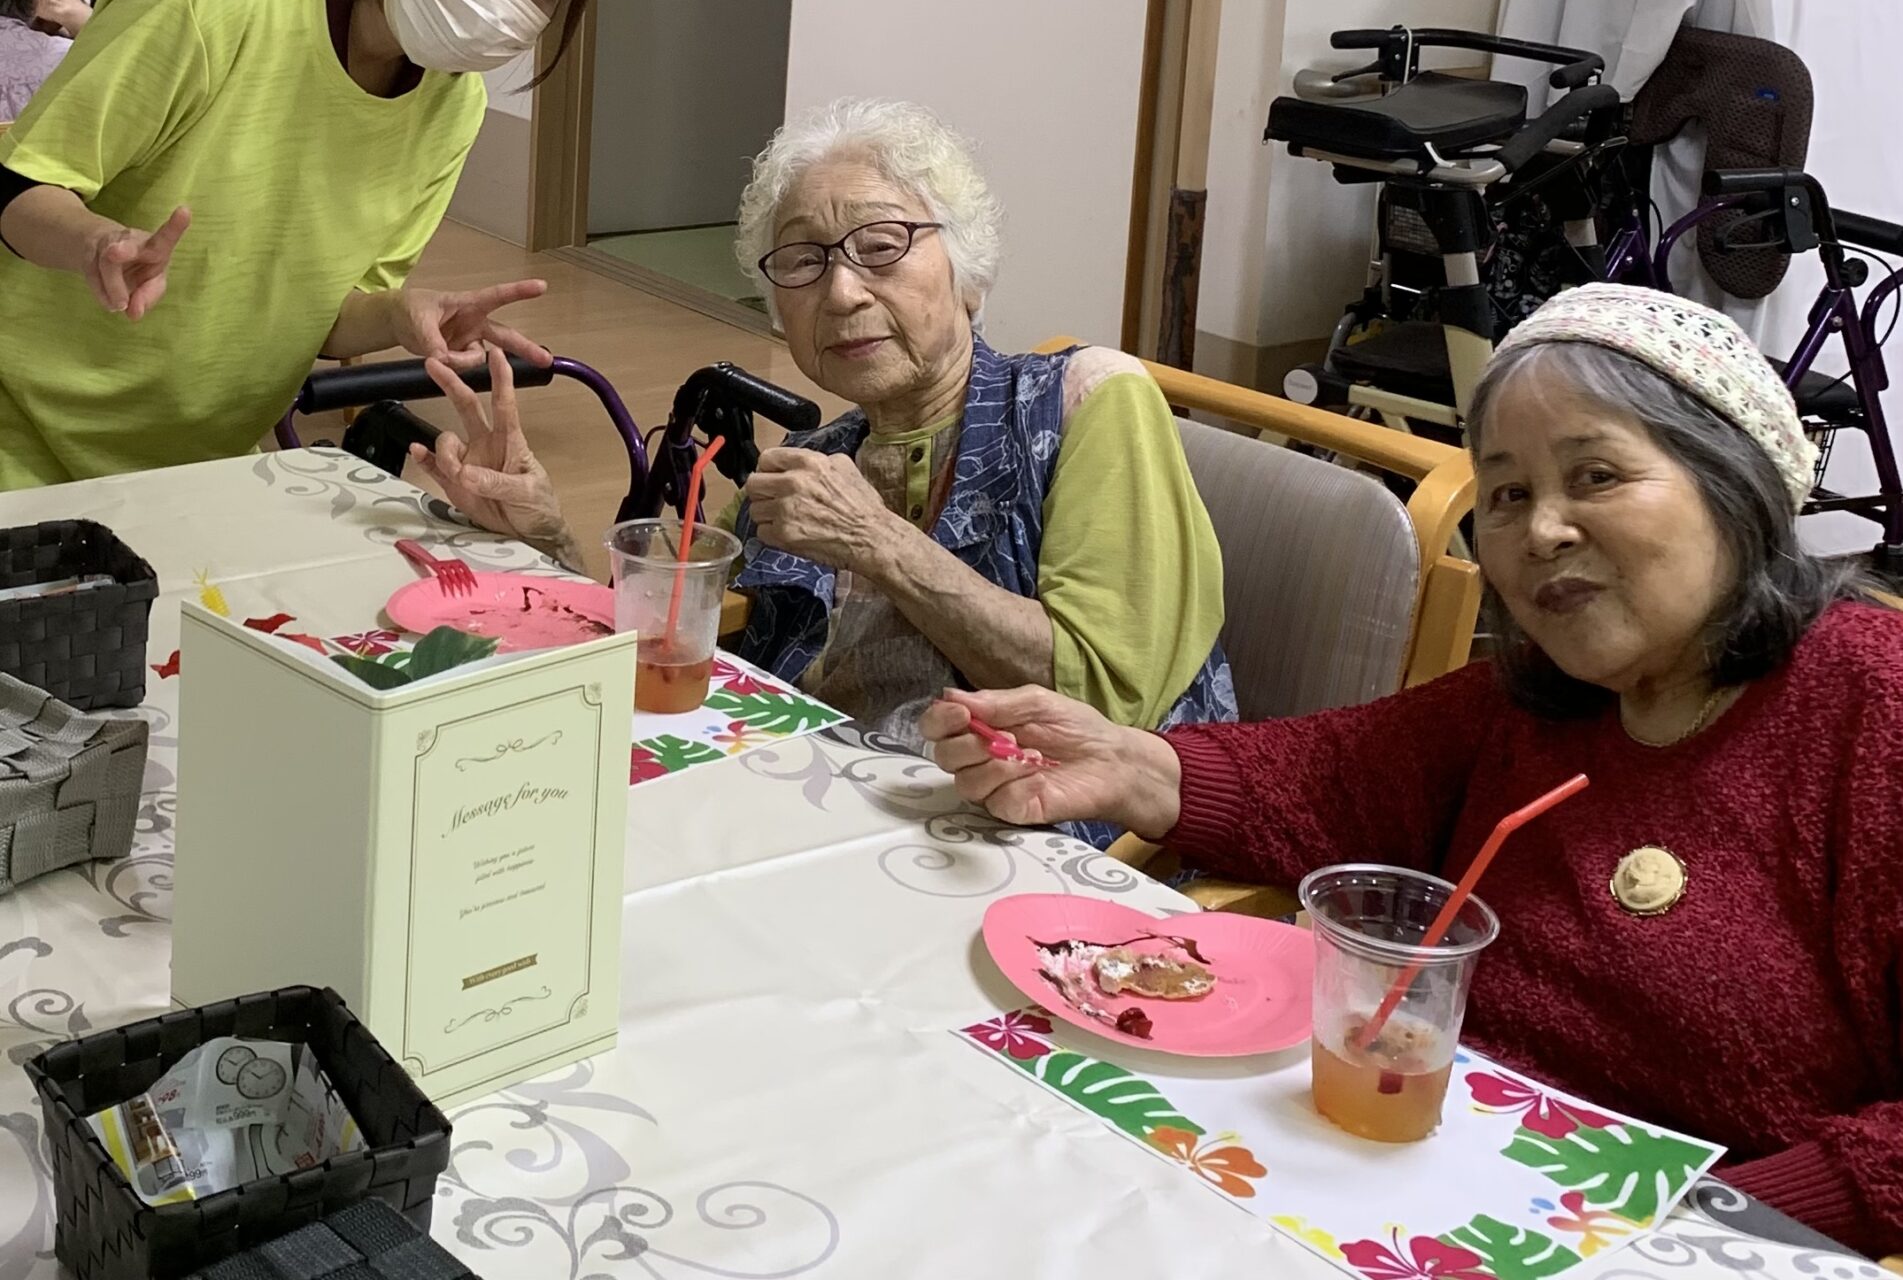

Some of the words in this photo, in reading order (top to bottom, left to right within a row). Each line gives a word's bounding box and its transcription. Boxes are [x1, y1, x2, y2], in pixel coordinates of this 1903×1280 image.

[441, 793, 512, 839] Message
[511, 781, 538, 810] for
[534, 788, 569, 806] you
